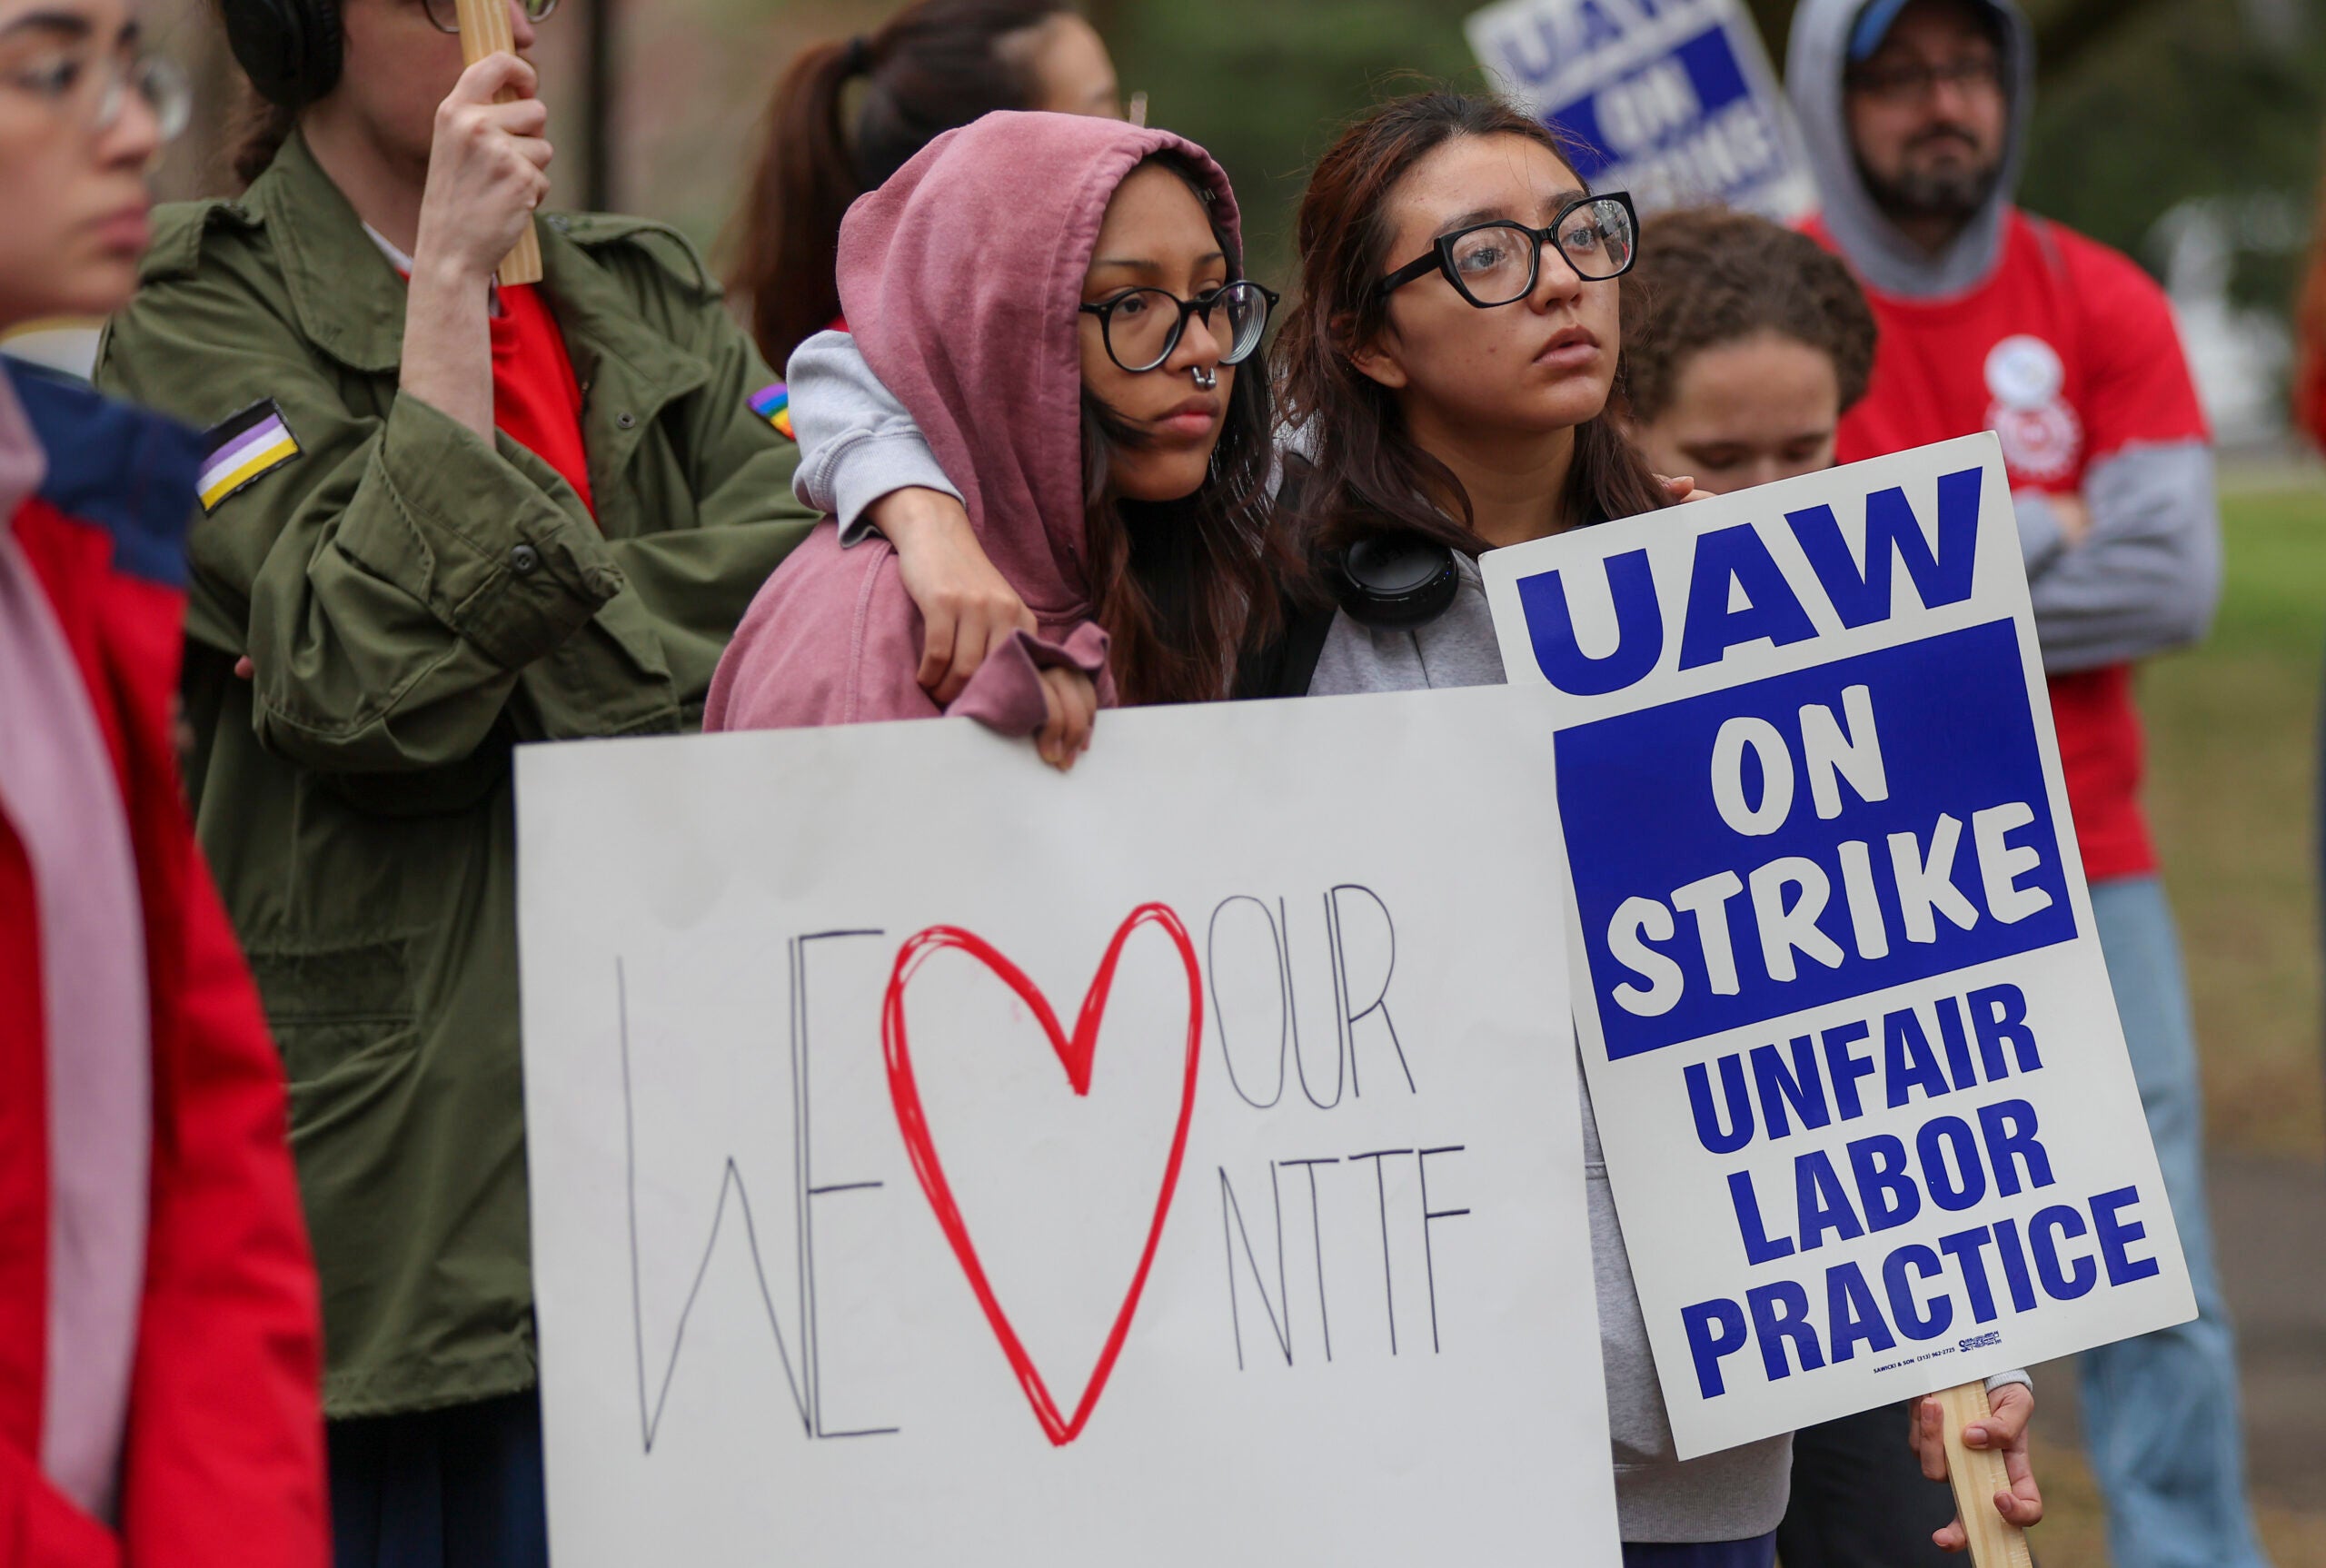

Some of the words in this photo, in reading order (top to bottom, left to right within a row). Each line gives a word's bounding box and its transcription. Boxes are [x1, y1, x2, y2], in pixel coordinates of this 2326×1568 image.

[1496, 0, 1692, 84] UA
[1516, 467, 1983, 696] UAW
[1712, 685, 1888, 837] ON
[1608, 802, 2053, 1017] STRIKE
[1685, 984, 2043, 1154] UNFAIR
[615, 928, 900, 1455] WE
[1208, 884, 1416, 1110] OUR
[1218, 1145, 1471, 1371] NTTF
[1728, 1099, 2055, 1265] LABOR
[1682, 1186, 2160, 1400] PRACTICE
[1874, 1363, 1896, 1374] SAWICKI
[1917, 1354, 1931, 1362] (313)
